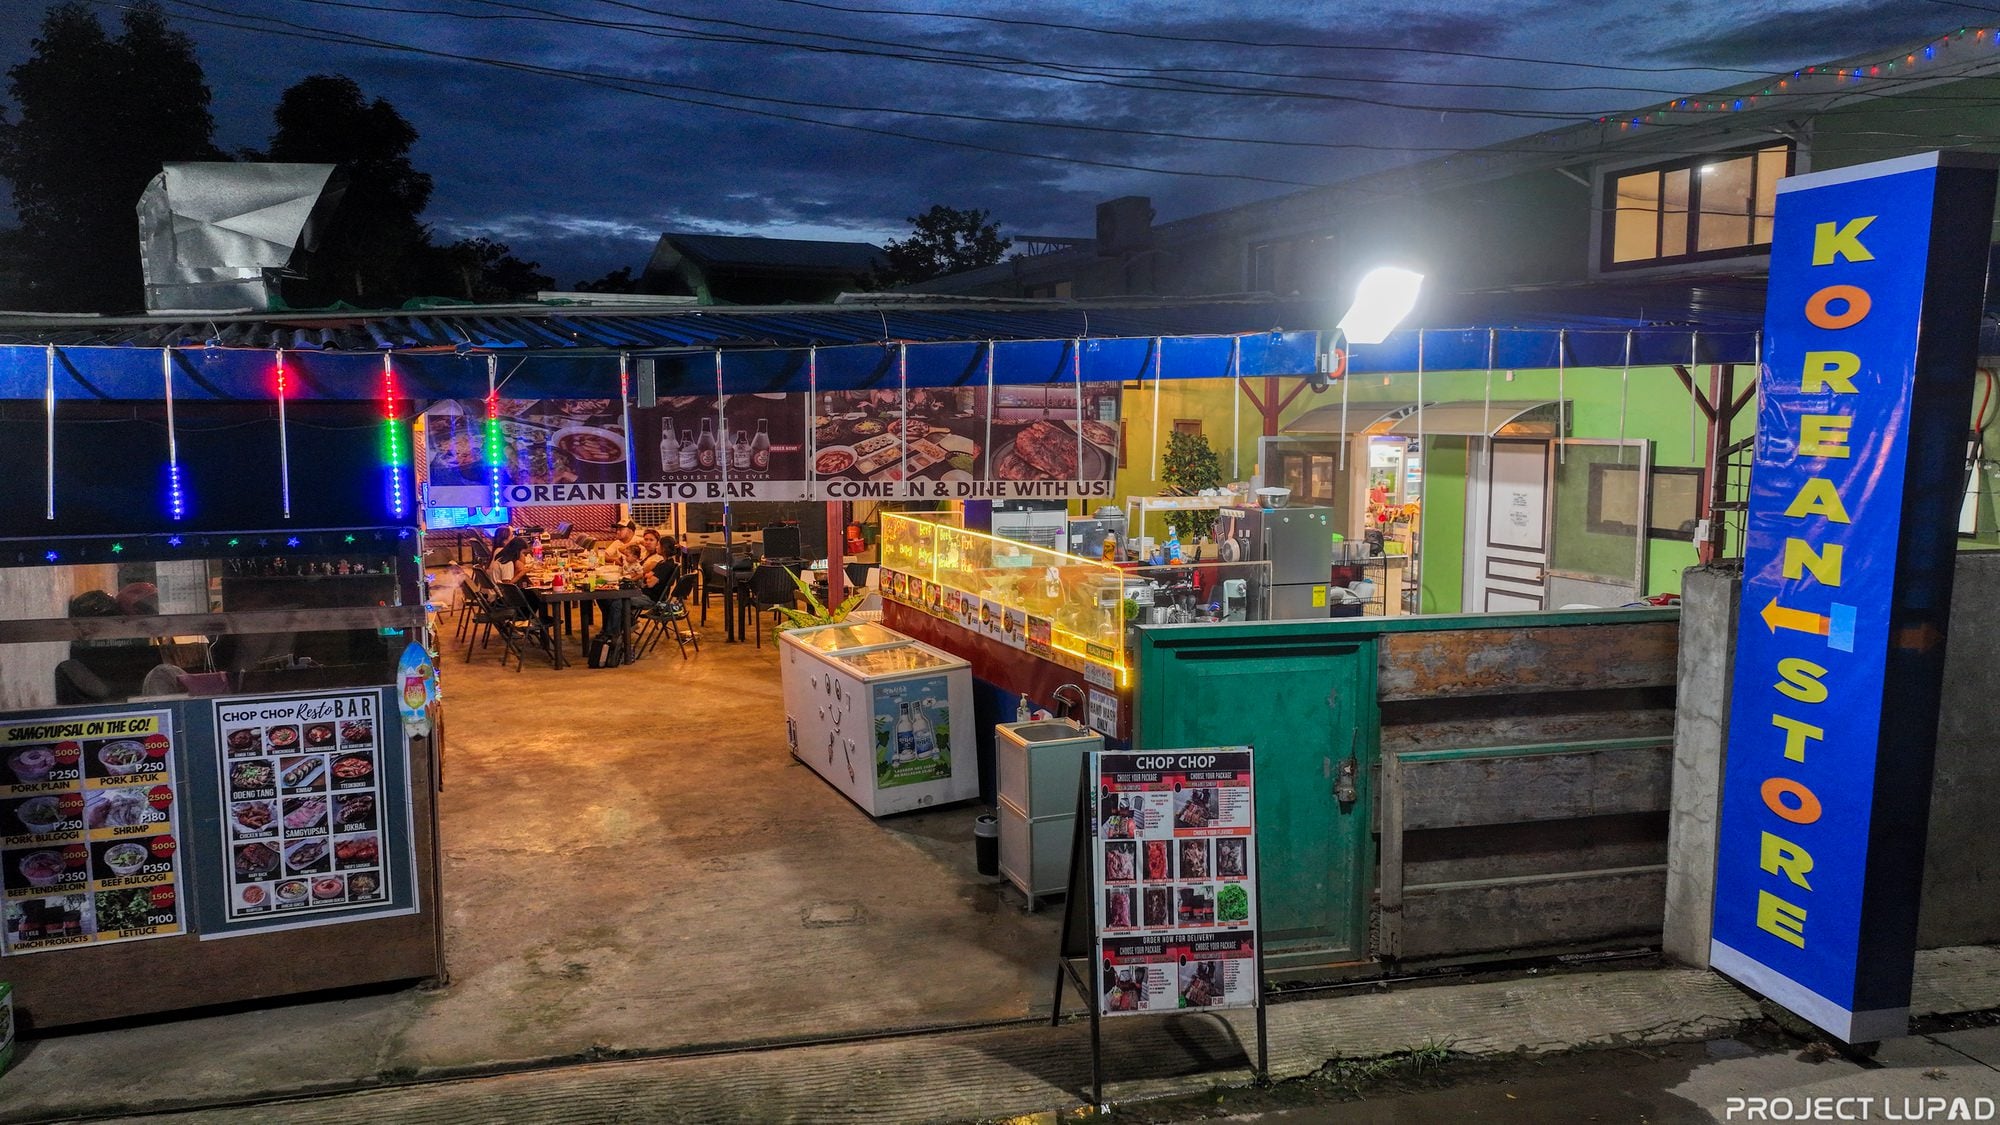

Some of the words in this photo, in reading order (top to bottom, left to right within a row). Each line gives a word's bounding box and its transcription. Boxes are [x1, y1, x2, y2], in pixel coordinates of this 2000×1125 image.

[1781, 215, 1878, 587] KOREAN
[616, 482, 697, 500] RESTO
[706, 482, 756, 498] BAR
[826, 482, 894, 498] COME
[902, 482, 924, 496] N
[932, 482, 950, 496] &
[957, 481, 1006, 496] DINE
[1014, 481, 1068, 496] WITH
[1076, 481, 1110, 496] US!
[222, 710, 258, 722] CHOP
[260, 708, 296, 720] CHOP
[296, 701, 335, 721] Resto
[334, 698, 372, 718] BAR
[8, 723, 84, 741] SAMGYUPSAL
[87, 721, 104, 736] ON
[106, 720, 126, 734] THE
[129, 718, 151, 732] GO!
[145, 741, 170, 750] 500G
[54, 748, 80, 758] 500G
[136, 762, 164, 773] P250
[1136, 756, 1175, 770] CHOP
[1178, 755, 1216, 769] CHOP
[50, 770, 79, 780] P250
[100, 775, 127, 786] PORK
[129, 773, 160, 784] JEYUK
[11, 783, 39, 793] PORK
[42, 780, 70, 791] PLAIN
[149, 792, 173, 802] 250G
[233, 791, 256, 800] ODENG
[257, 789, 274, 798] TANG
[1756, 658, 1829, 950] STORE
[140, 812, 166, 823] P180
[54, 820, 83, 831] P250
[114, 824, 150, 836] SHRIMP
[344, 822, 366, 832] JOKBAL
[6, 835, 32, 846] PORK
[36, 831, 80, 844] BULGOGI
[286, 828, 328, 838] SAMGYUPSAL
[152, 842, 176, 850] 500G
[143, 862, 171, 874] P350
[58, 872, 86, 882] P350
[101, 878, 125, 888] BEEF
[126, 873, 167, 886] BULGOGI
[8, 886, 31, 897] BEEF
[32, 882, 86, 895] TENDERLOIN
[152, 892, 176, 901] 150G
[148, 914, 174, 924] P100
[119, 926, 158, 938] LETTUCE
[14, 939, 44, 950] KIMCHI
[45, 935, 88, 946] PRODUCTS
[1142, 936, 1161, 944] ORDER
[1187, 934, 1215, 942] DELIVERY!
